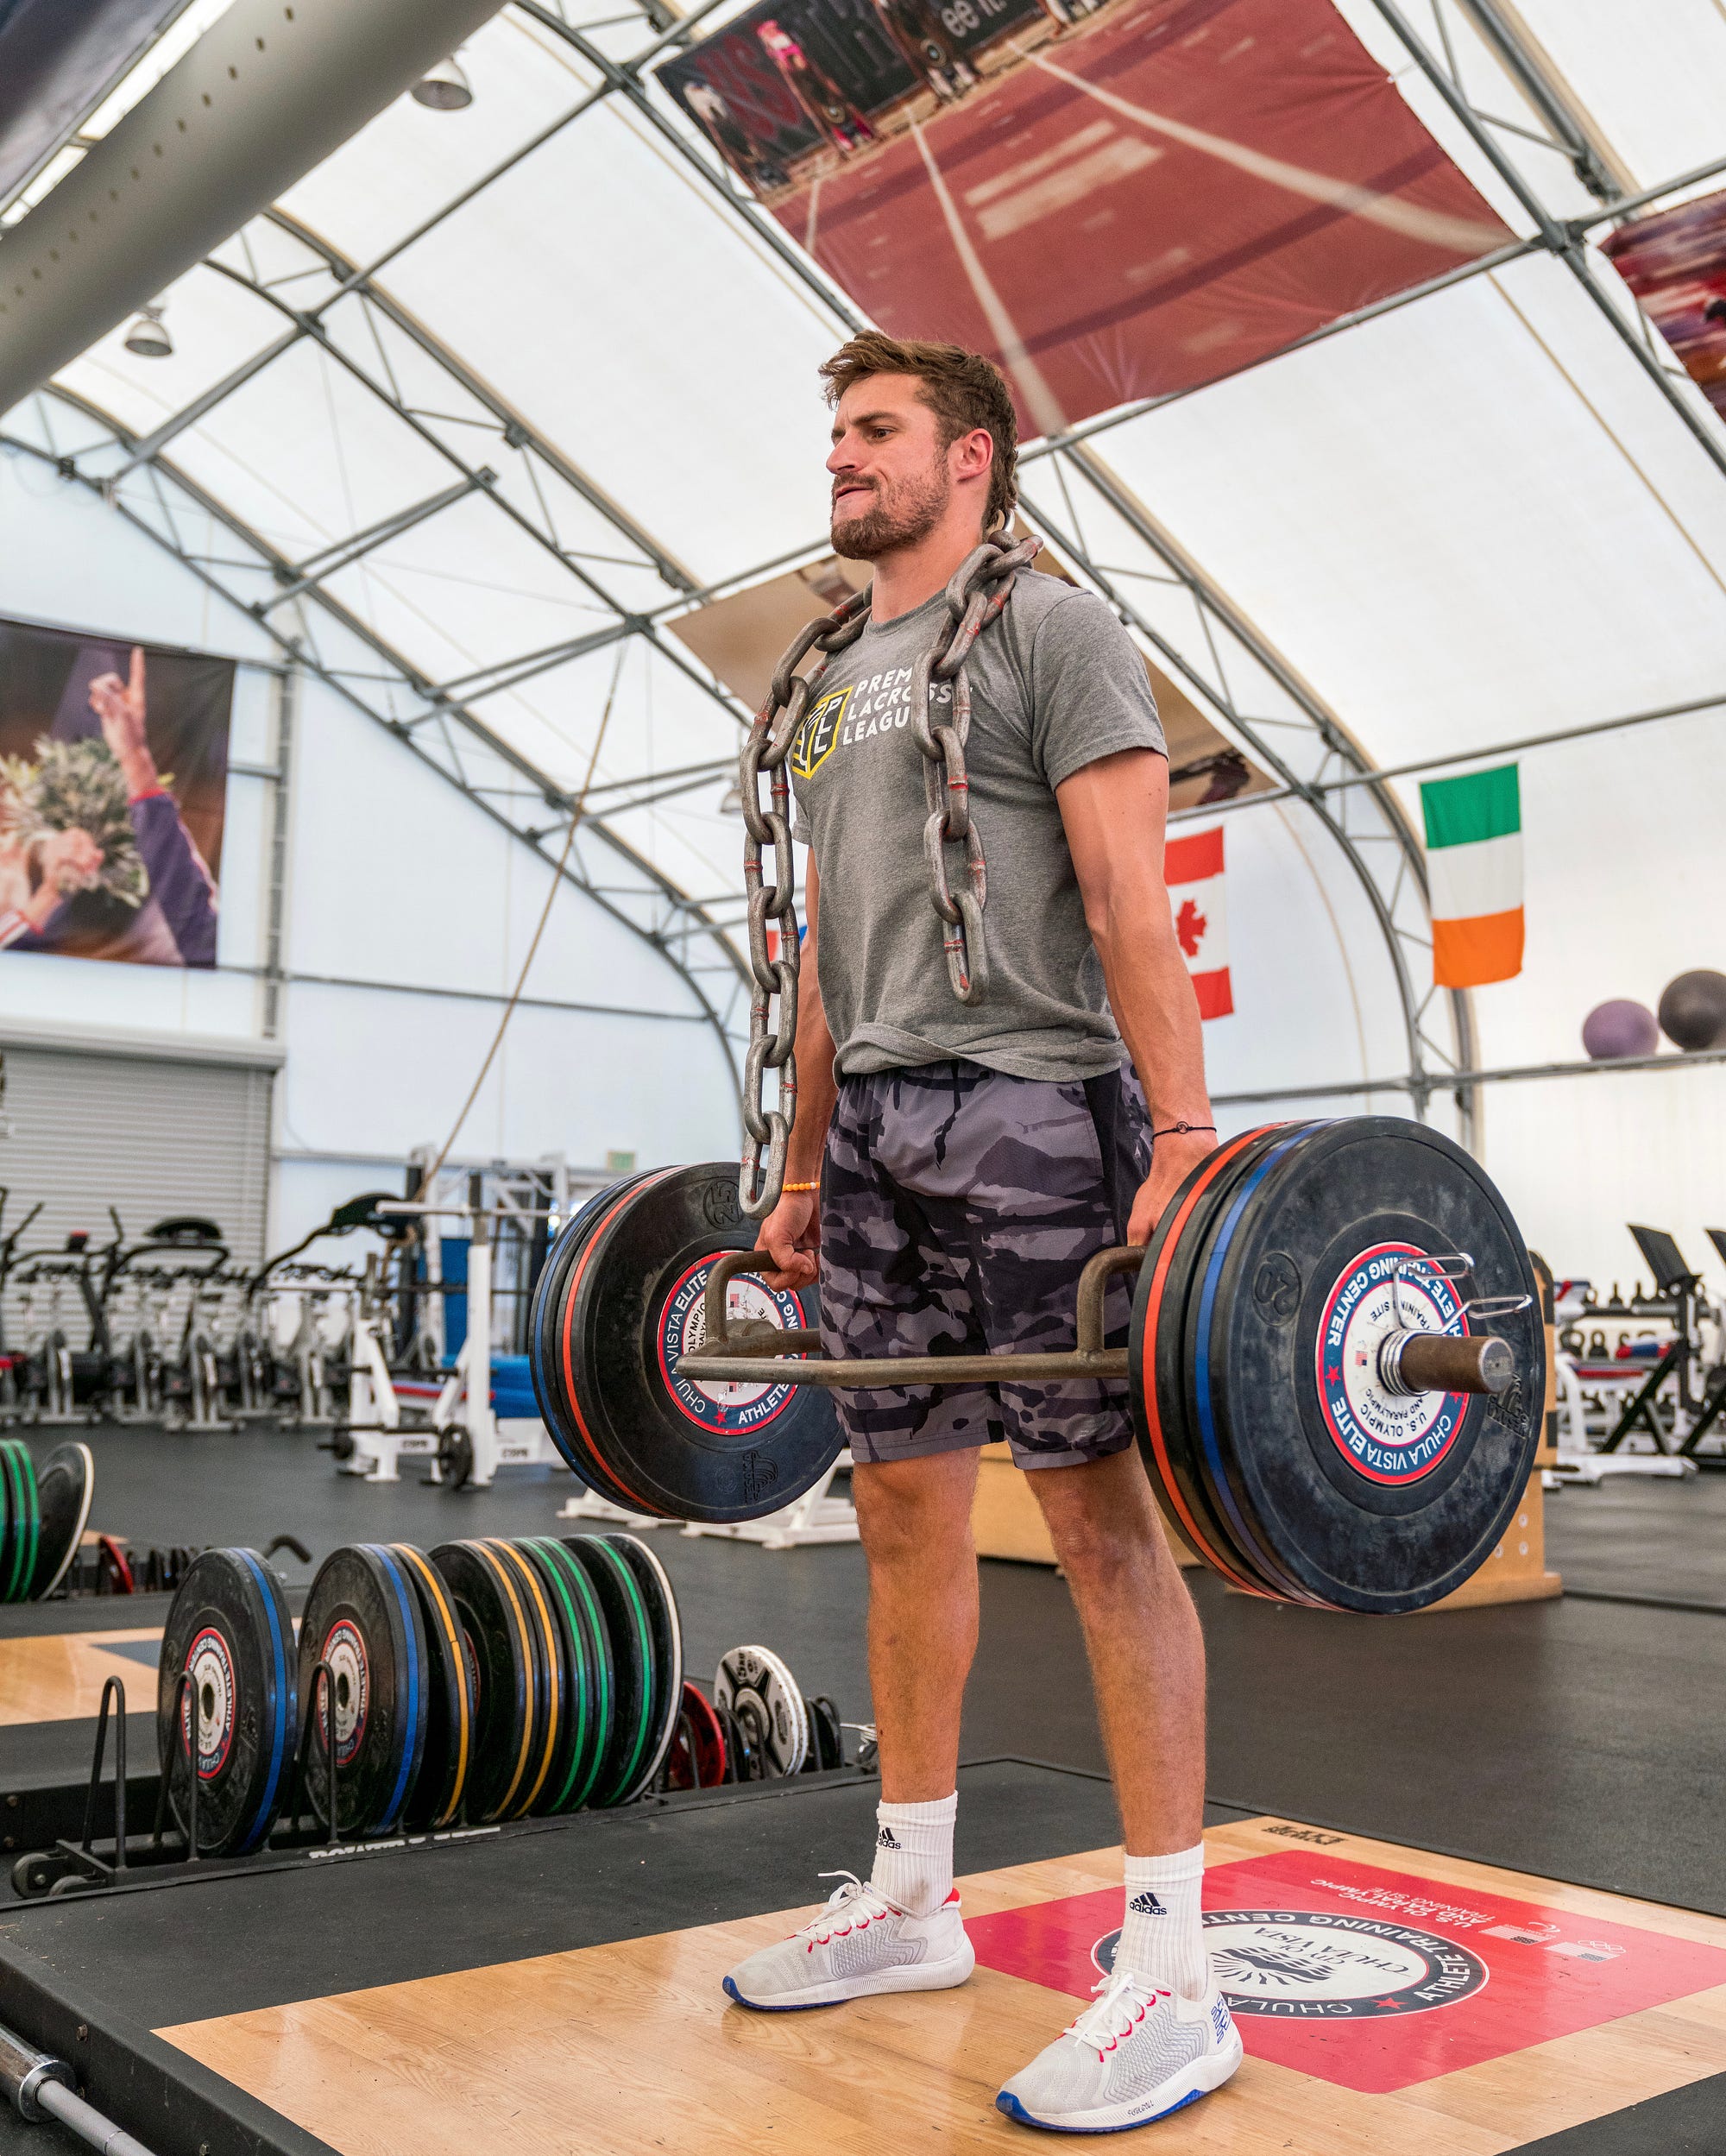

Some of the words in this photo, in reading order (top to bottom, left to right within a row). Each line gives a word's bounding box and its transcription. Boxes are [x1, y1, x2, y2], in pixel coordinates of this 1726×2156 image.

[854, 666, 913, 698] PREM
[842, 705, 910, 746] LEAGU
[675, 1269, 708, 1312] ELITE
[1327, 1271, 1369, 1346] CENTER
[1370, 1301, 1390, 1322] SITE
[738, 1383, 791, 1425] ATHLETE
[1360, 1403, 1404, 1437] OLYMPIC
[1365, 1388, 1408, 1421] PARALYMPIC
[1409, 1396, 1424, 1415] AND
[1331, 1396, 1368, 1456] ELITE
[1407, 1412, 1428, 1432] U.S.
[1408, 1415, 1452, 1466] CHULA
[1366, 1443, 1408, 1471] VISTA
[1130, 1901, 1167, 1915] adidas
[1310, 1879, 1438, 1913] PARALYMPIC
[1339, 1893, 1428, 1917] OLYMPIC
[1203, 1913, 1295, 1926] CENT
[1439, 1910, 1488, 1925] AND
[1253, 1926, 1314, 1951] VISTA
[1308, 1915, 1449, 1953] TRAINING
[1320, 1945, 1409, 1975] CHULA
[1413, 1952, 1471, 2001] ATHLETE
[1226, 1996, 1352, 2014] CHULA
